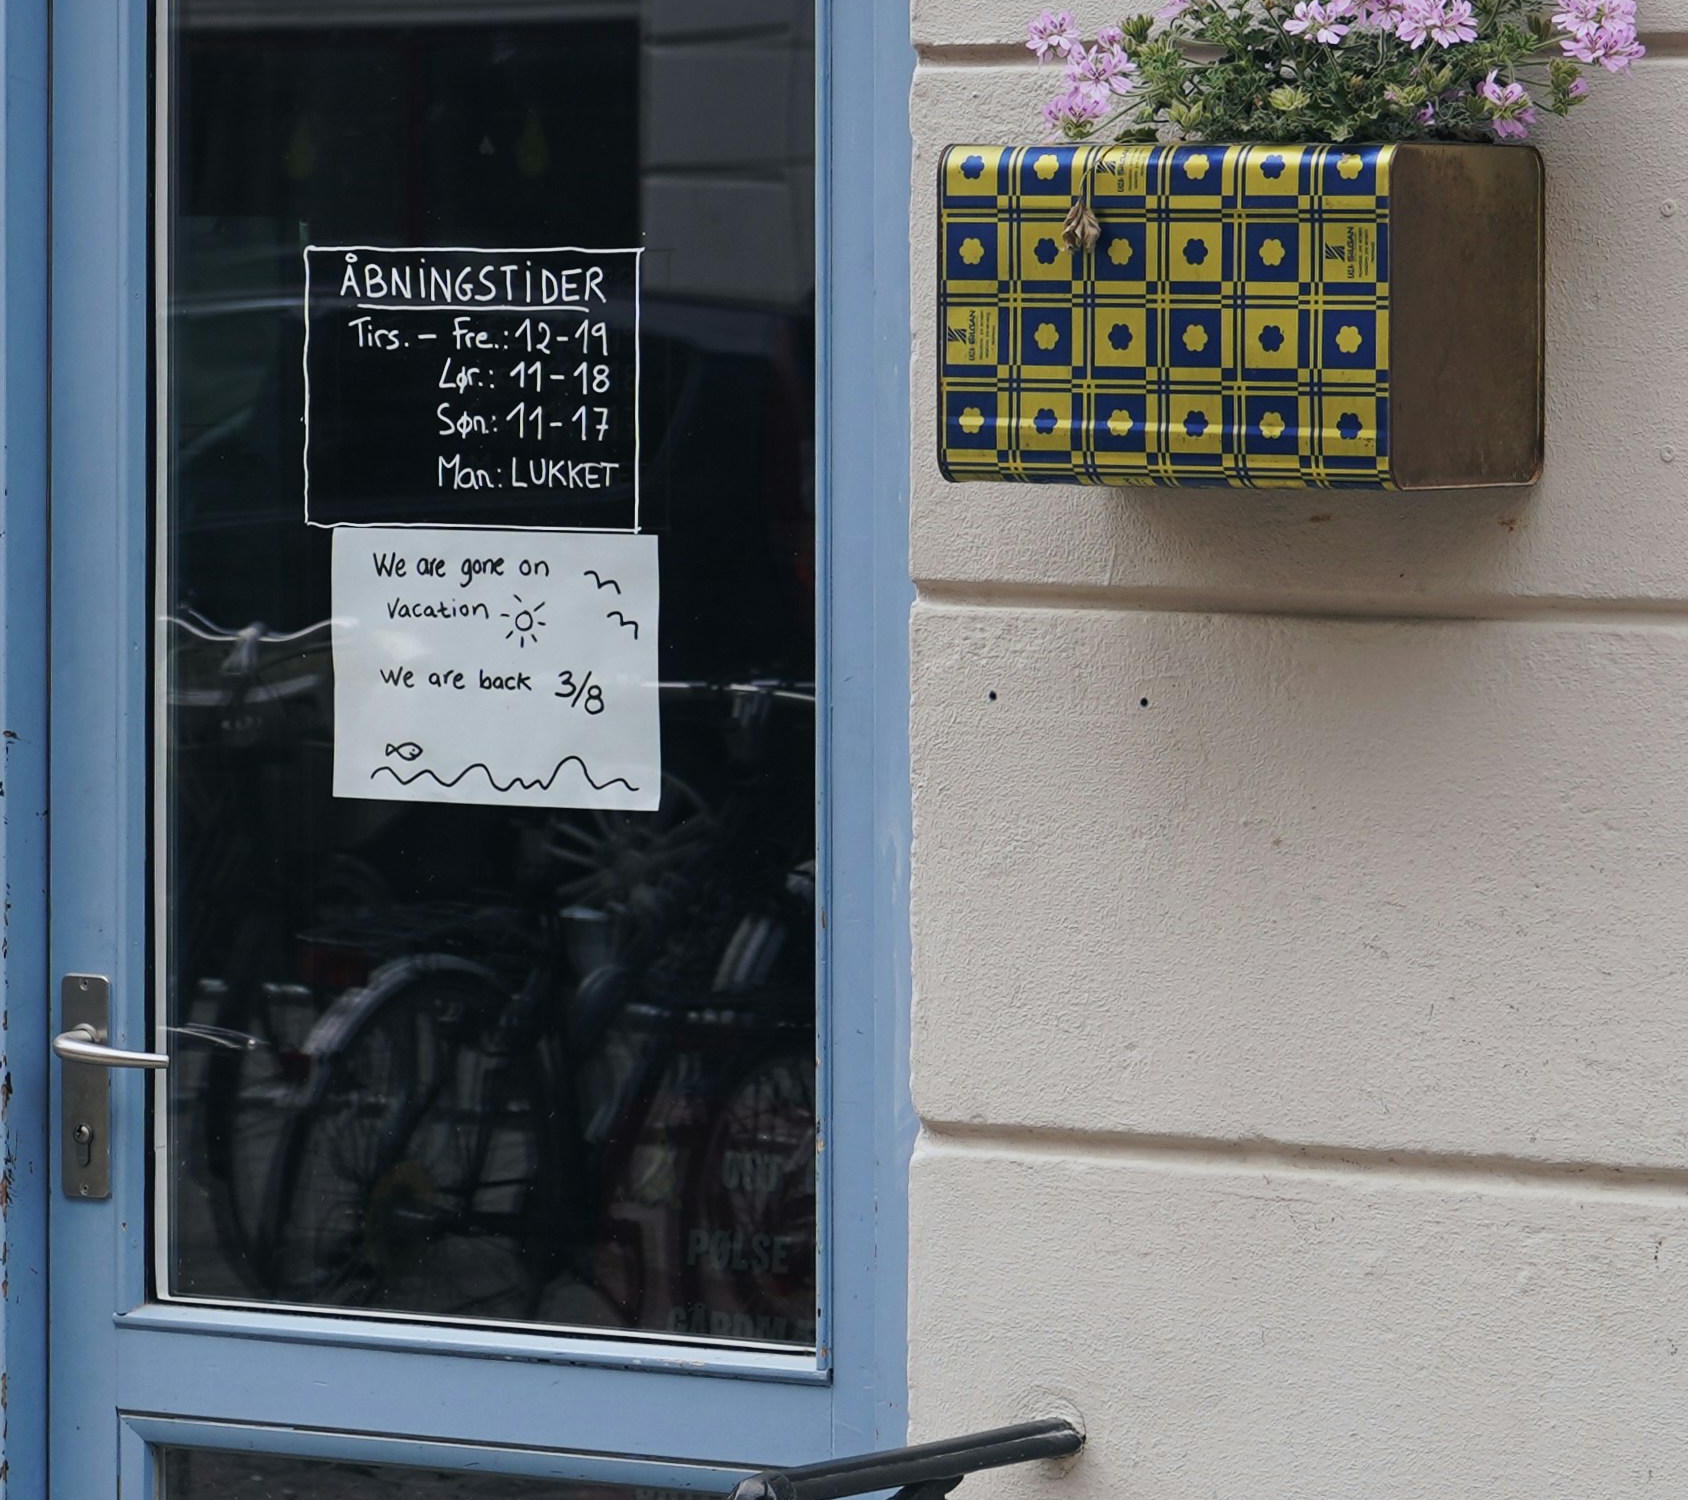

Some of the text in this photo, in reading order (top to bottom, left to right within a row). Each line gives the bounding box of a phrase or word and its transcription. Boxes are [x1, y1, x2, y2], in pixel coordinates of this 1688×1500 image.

[349, 316, 410, 351] Tirs.
[509, 359, 610, 396] 11-18
[505, 401, 610, 441] 11-17
[438, 455, 619, 490] Man: LUKKET
[373, 551, 550, 588] We are gone on
[386, 597, 490, 621] Vacation
[379, 666, 605, 714] We are back 3/8
[687, 1228, 792, 1276] PØLSE
